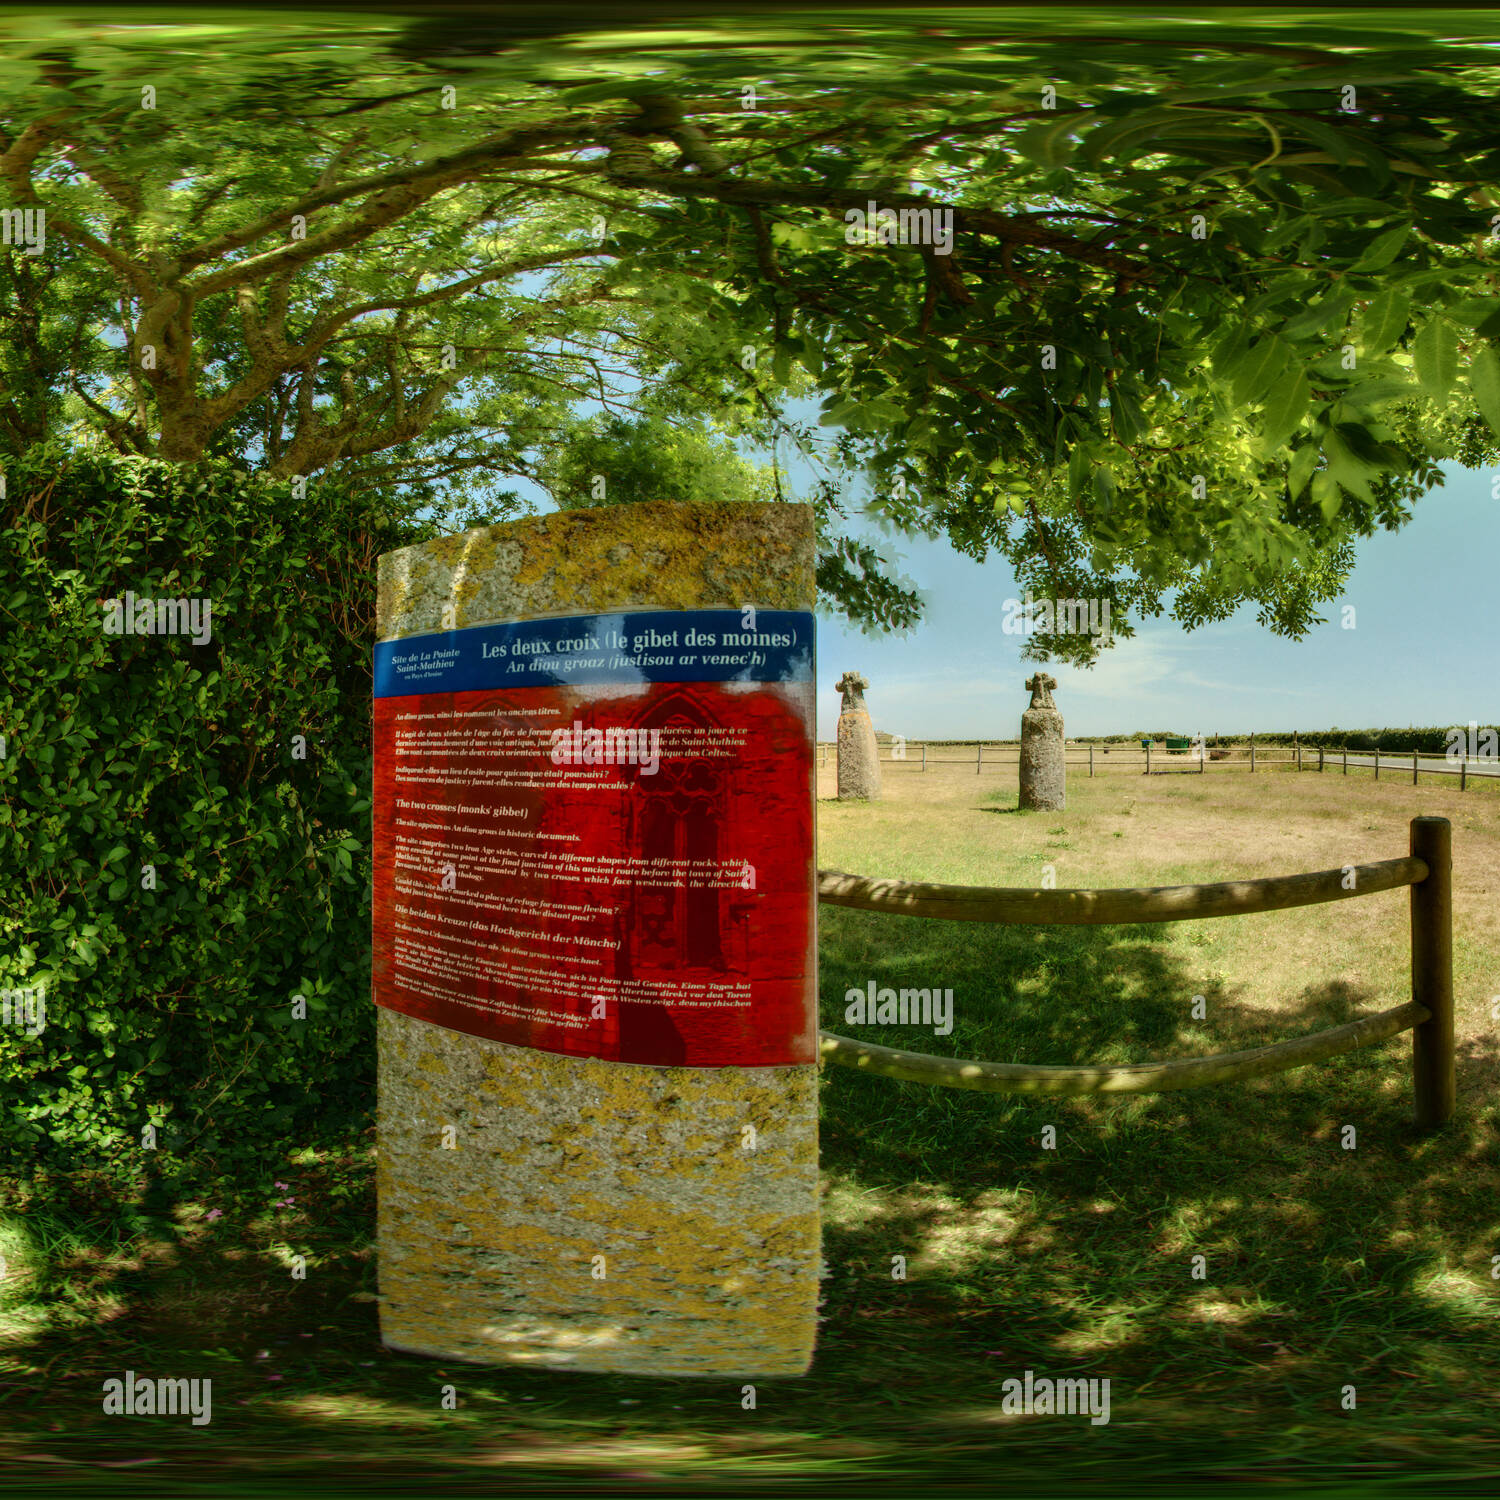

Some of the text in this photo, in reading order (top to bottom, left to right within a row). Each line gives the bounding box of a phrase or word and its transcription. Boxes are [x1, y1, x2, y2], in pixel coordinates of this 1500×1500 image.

[482, 628, 798, 660] Les deux croix (le gibet des moines)
[391, 648, 460, 665] Site de La Pointe
[506, 660, 526, 674] An
[563, 657, 605, 673] groaz
[679, 654, 697, 666] ar
[396, 659, 455, 673] Saint-Mathieu
[517, 728, 527, 736] de
[707, 726, 727, 736] jour
[557, 780, 570, 789] des
[572, 781, 596, 791] temps
[395, 799, 410, 808] The
[411, 800, 426, 810] two
[427, 803, 457, 812] crosses
[493, 805, 528, 819] gibbet)
[507, 828, 535, 839] historic
[536, 831, 581, 841] documents.
[488, 855, 501, 864] the
[555, 862, 565, 872] of
[565, 863, 580, 872] this
[582, 865, 614, 874] ancient
[616, 867, 640, 876] route
[641, 868, 670, 878] before
[672, 869, 687, 877] the
[713, 869, 723, 879] of
[549, 852, 557, 860] in
[559, 852, 595, 863] different
[597, 855, 626, 866] shapes
[627, 856, 649, 867] from
[651, 857, 690, 868] different
[722, 858, 749, 867] which
[534, 871, 549, 879] two
[584, 875, 609, 884] which
[612, 876, 632, 887] face
[690, 879, 704, 888] the
[571, 914, 590, 922] past
[409, 907, 437, 920] beiden
[438, 914, 468, 927] Kreuze
[490, 924, 551, 941] Hochgericht
[553, 933, 571, 943] der
[572, 936, 621, 950] Mönche)
[623, 979, 640, 987] und
